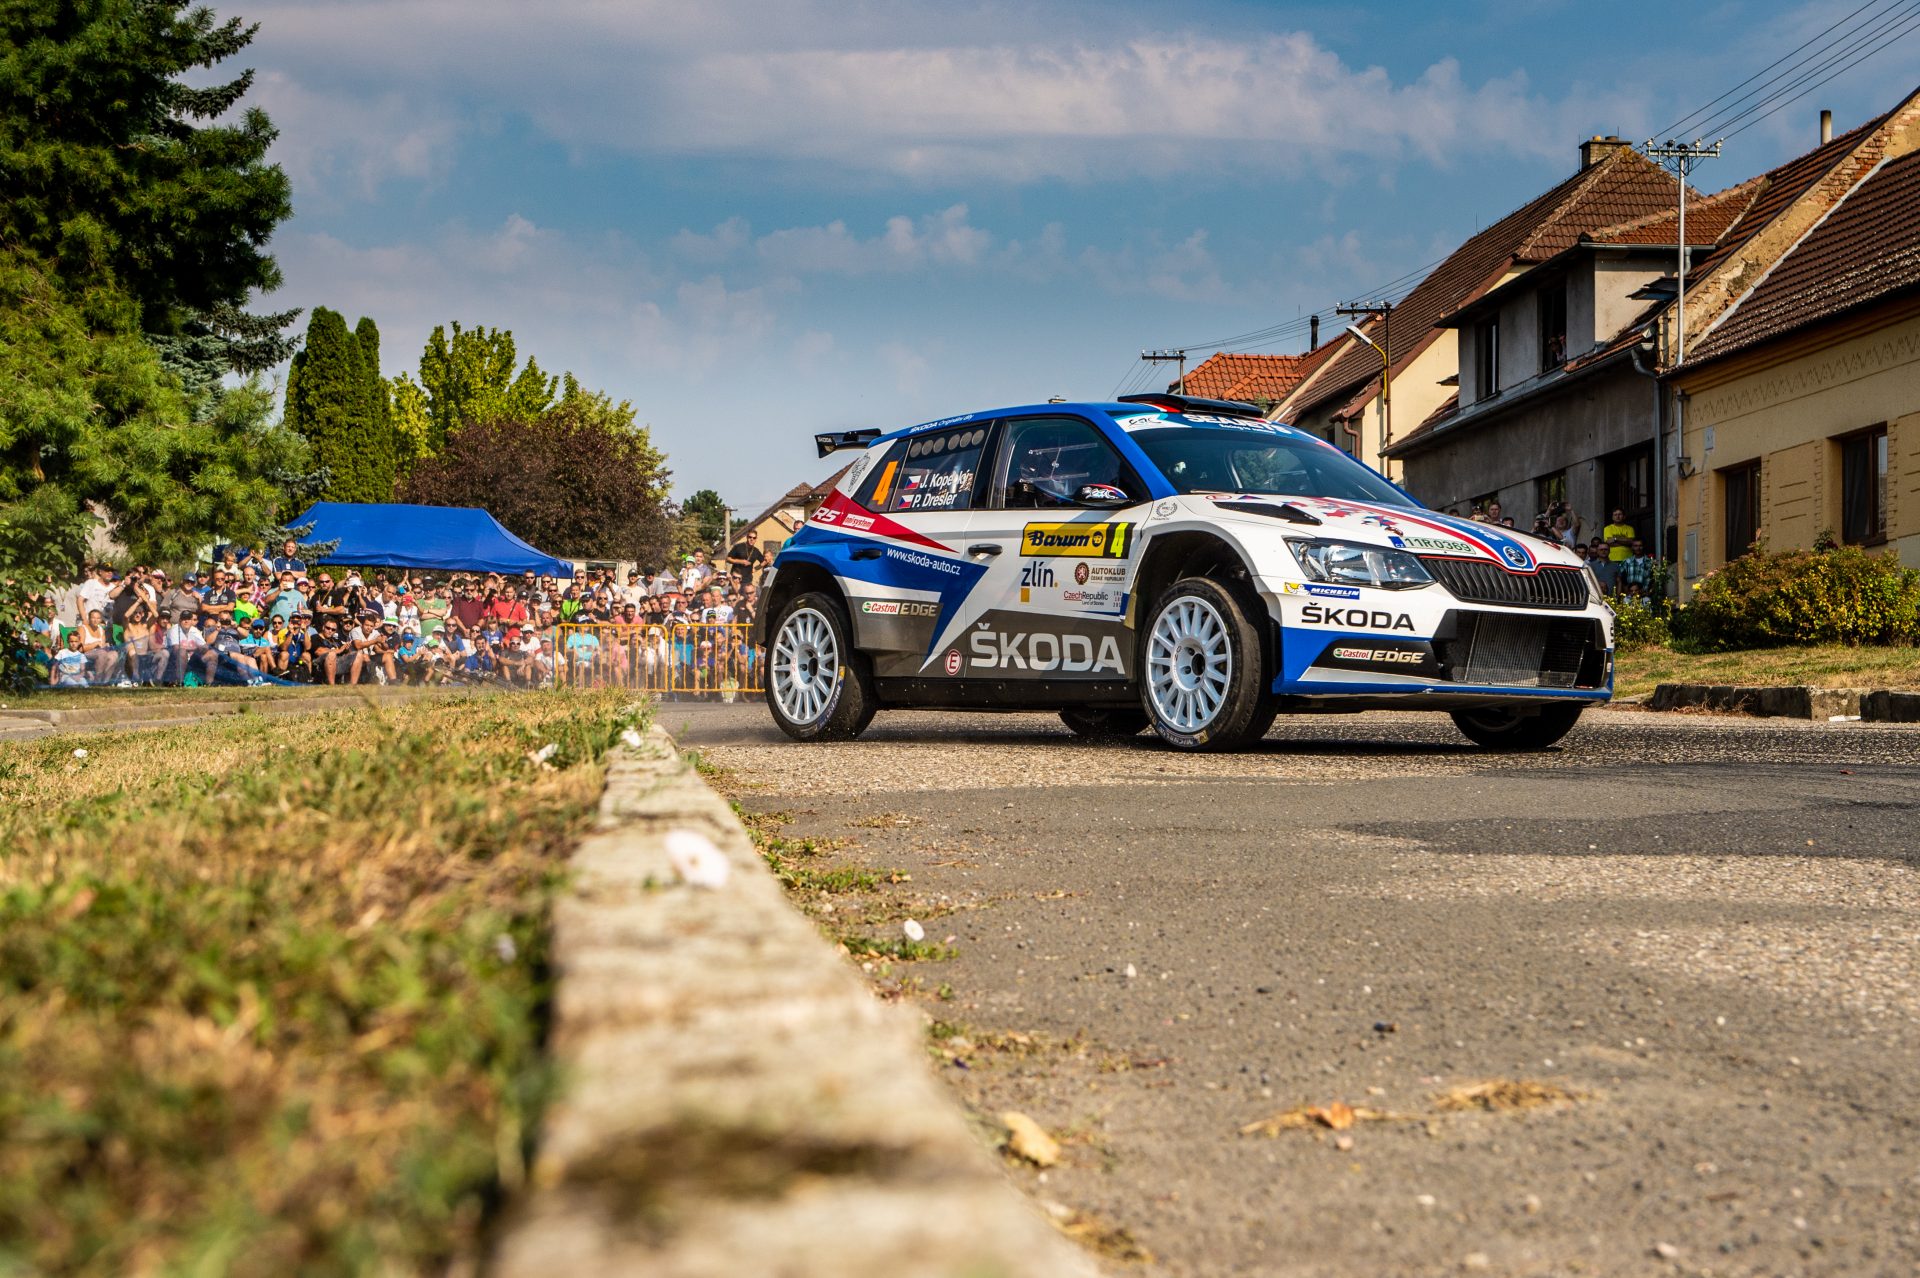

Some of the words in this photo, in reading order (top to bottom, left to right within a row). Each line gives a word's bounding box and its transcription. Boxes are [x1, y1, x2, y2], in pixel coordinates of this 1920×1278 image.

[872, 460, 899, 506] 4
[920, 473, 929, 489] J.
[930, 469, 970, 490] Kopeký
[912, 494, 921, 508] P.
[922, 491, 958, 508] Dresler
[1028, 530, 1090, 548] Barum
[1110, 523, 1129, 558] 4
[1434, 540, 1472, 552] 0369
[887, 547, 961, 576] www.skoda-auto.cz
[1091, 567, 1126, 576] AUTOKLUB
[1311, 587, 1360, 597] MICHELIN
[871, 602, 898, 613] Castrol
[900, 603, 938, 617] EDGE
[1301, 602, 1416, 632] ŠKODA
[970, 622, 1126, 675] ŠKODA
[1343, 649, 1370, 659] Castrol
[1372, 650, 1426, 664] EDGE
